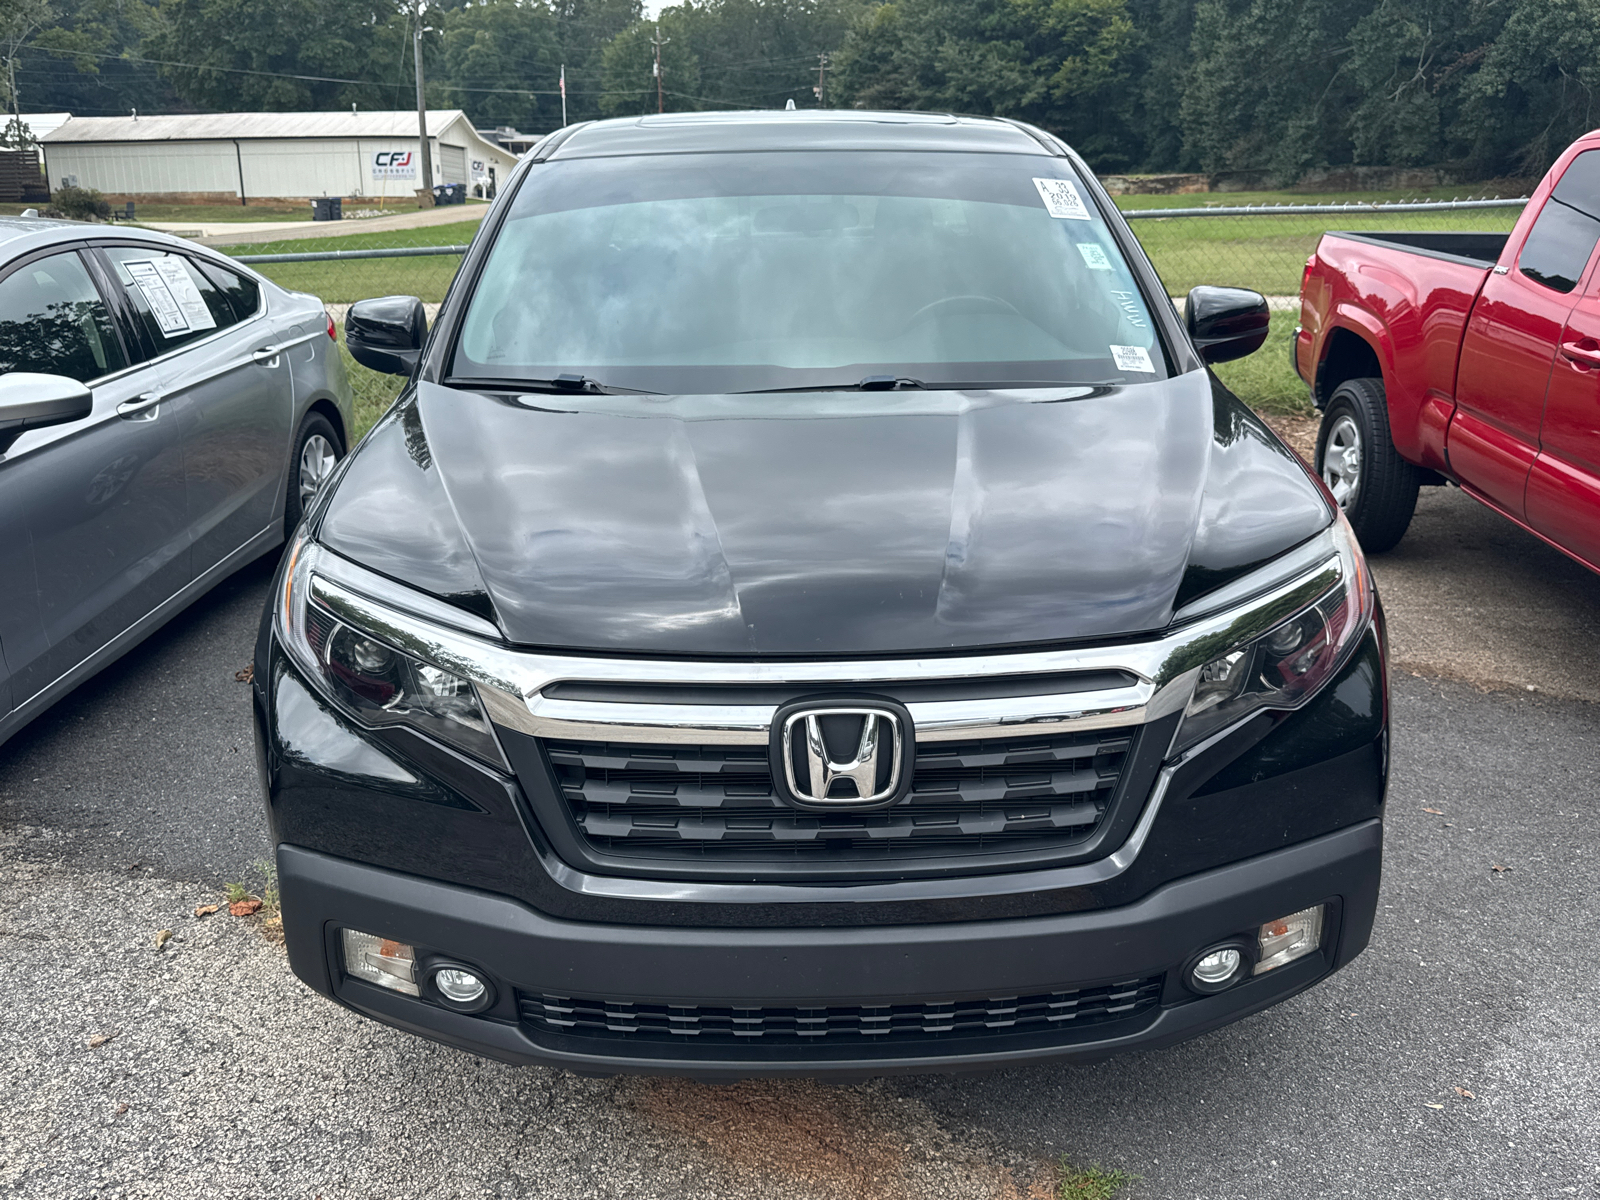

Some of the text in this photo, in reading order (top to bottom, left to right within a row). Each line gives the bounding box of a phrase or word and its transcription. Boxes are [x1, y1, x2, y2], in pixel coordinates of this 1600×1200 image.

[375, 152, 412, 166] CFJ
[1040, 181, 1070, 194] A 33
[1049, 193, 1077, 201] 2019
